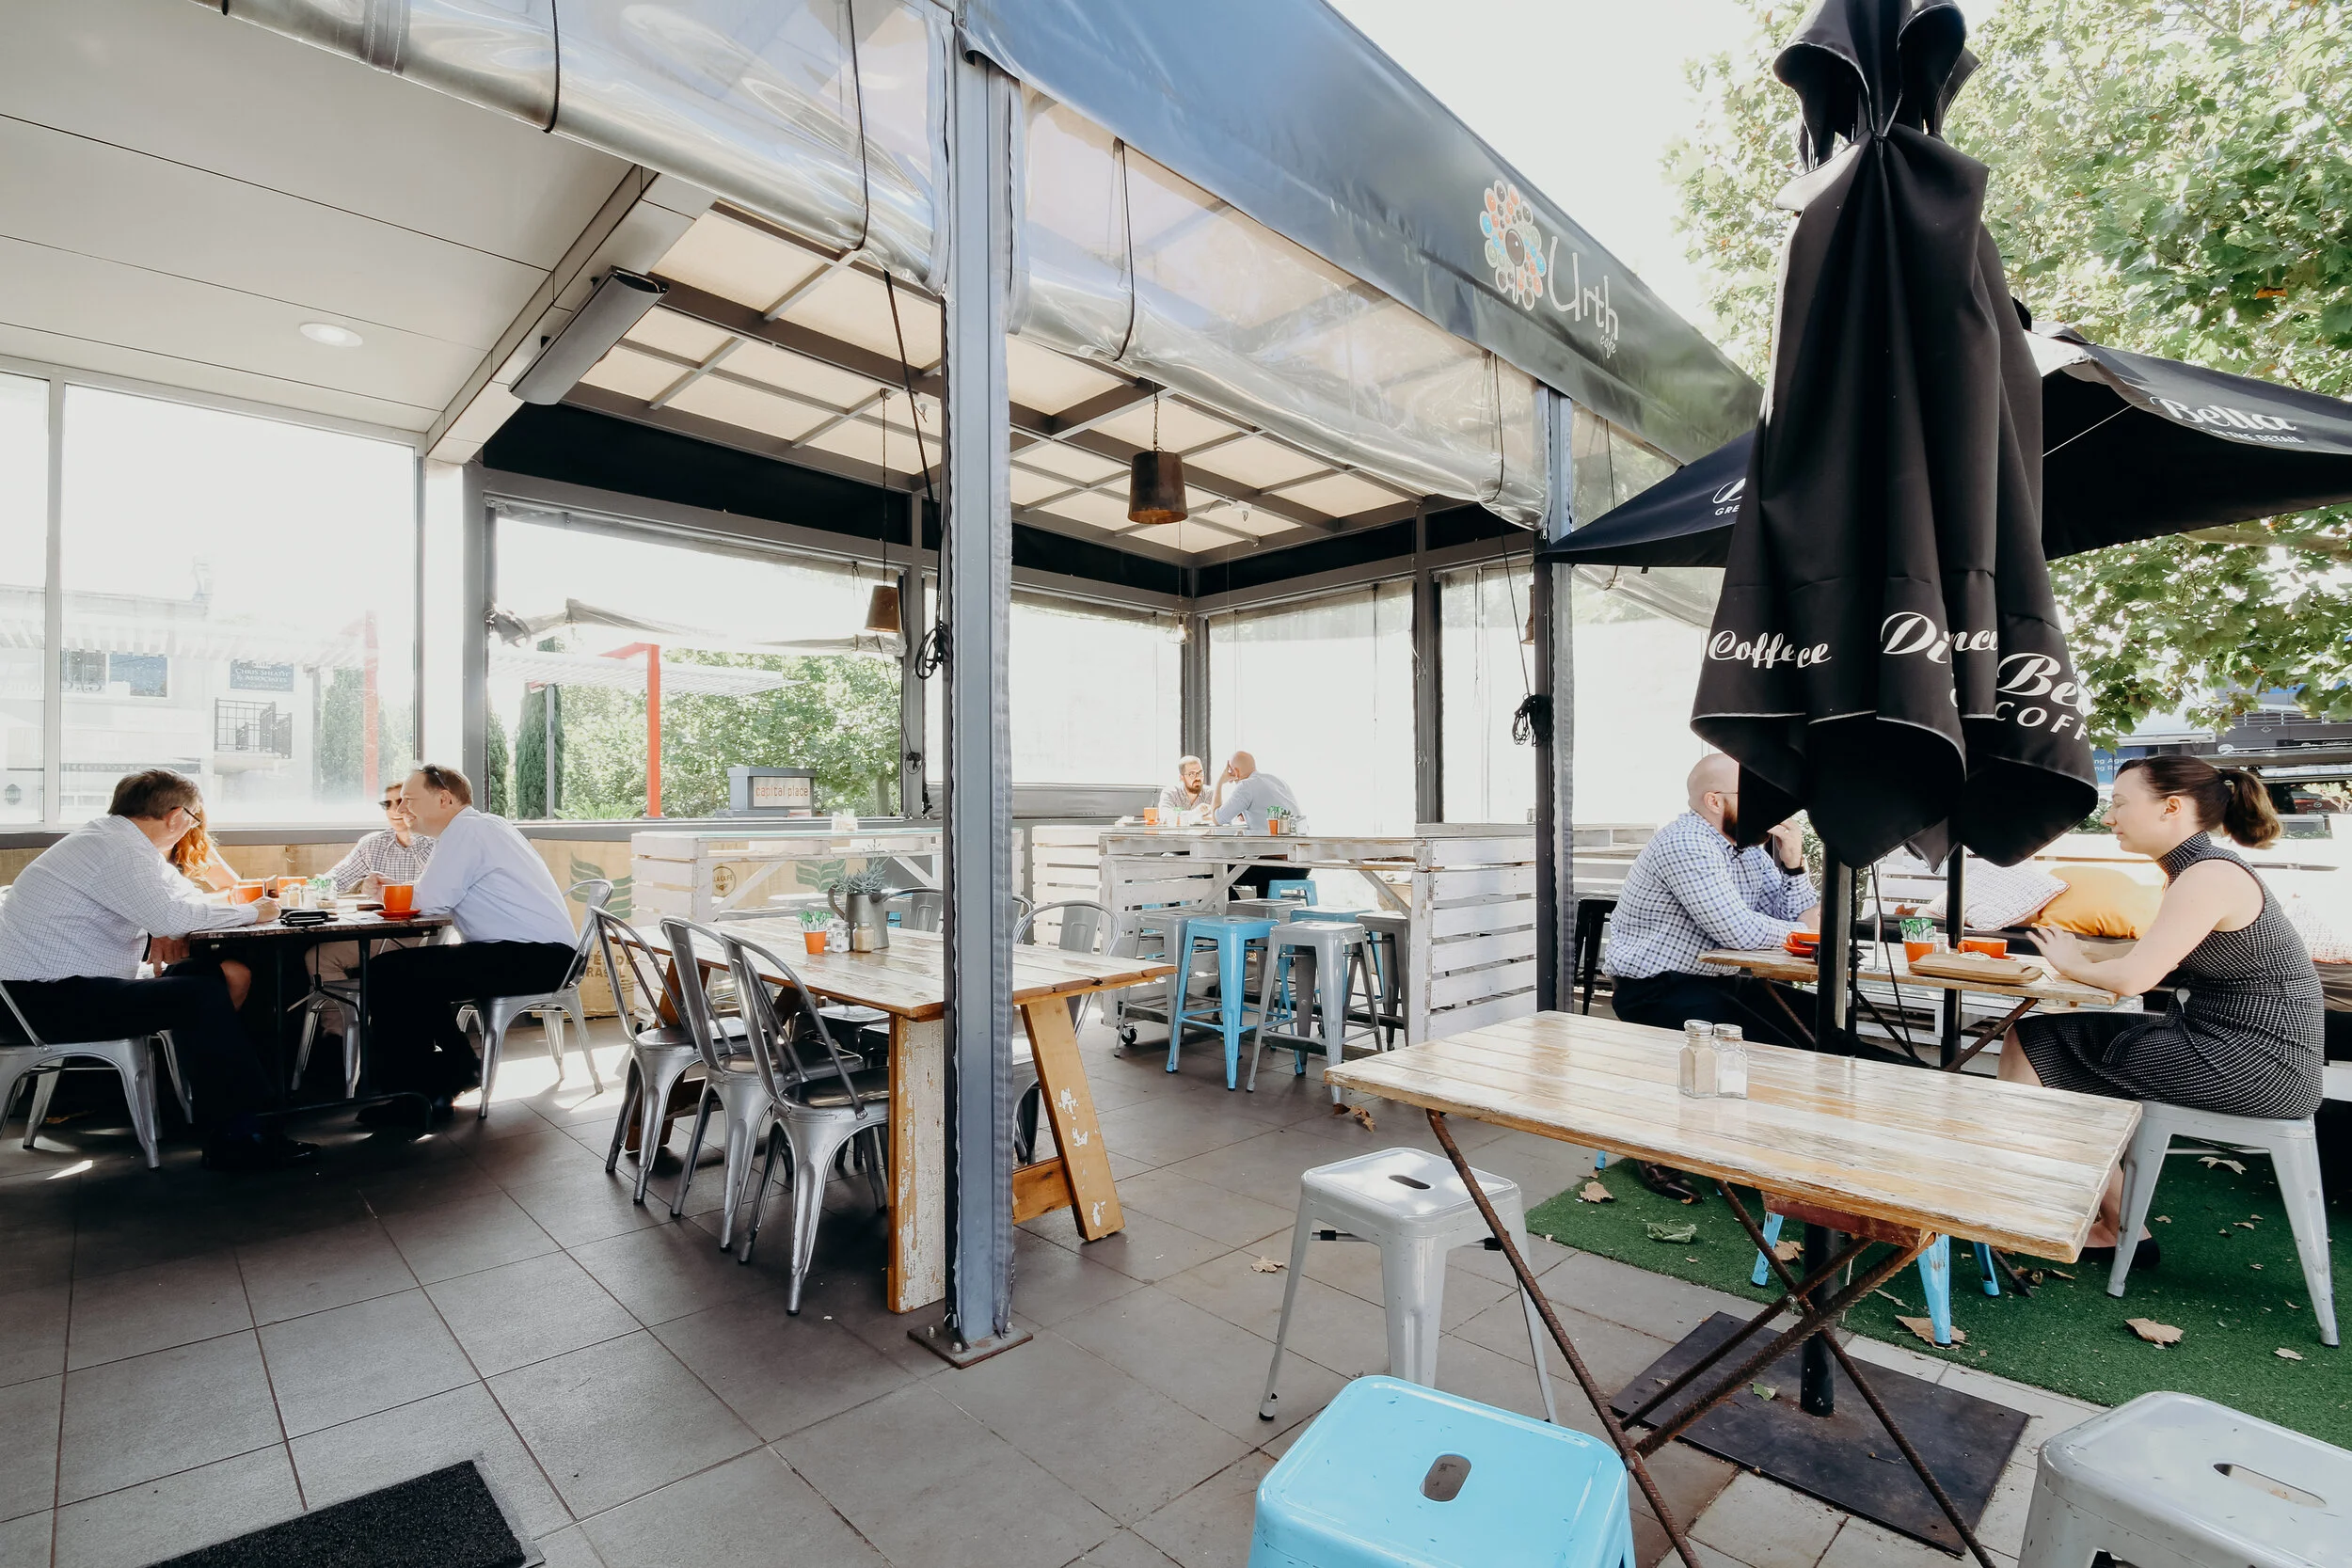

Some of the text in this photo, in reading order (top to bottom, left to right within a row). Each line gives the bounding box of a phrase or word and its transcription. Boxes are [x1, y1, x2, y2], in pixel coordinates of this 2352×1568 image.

[1548, 236, 1618, 341] Urth
[2150, 397, 2296, 431] Bella
[2255, 435, 2305, 443] DETAIL
[755, 784, 809, 799] capital place
